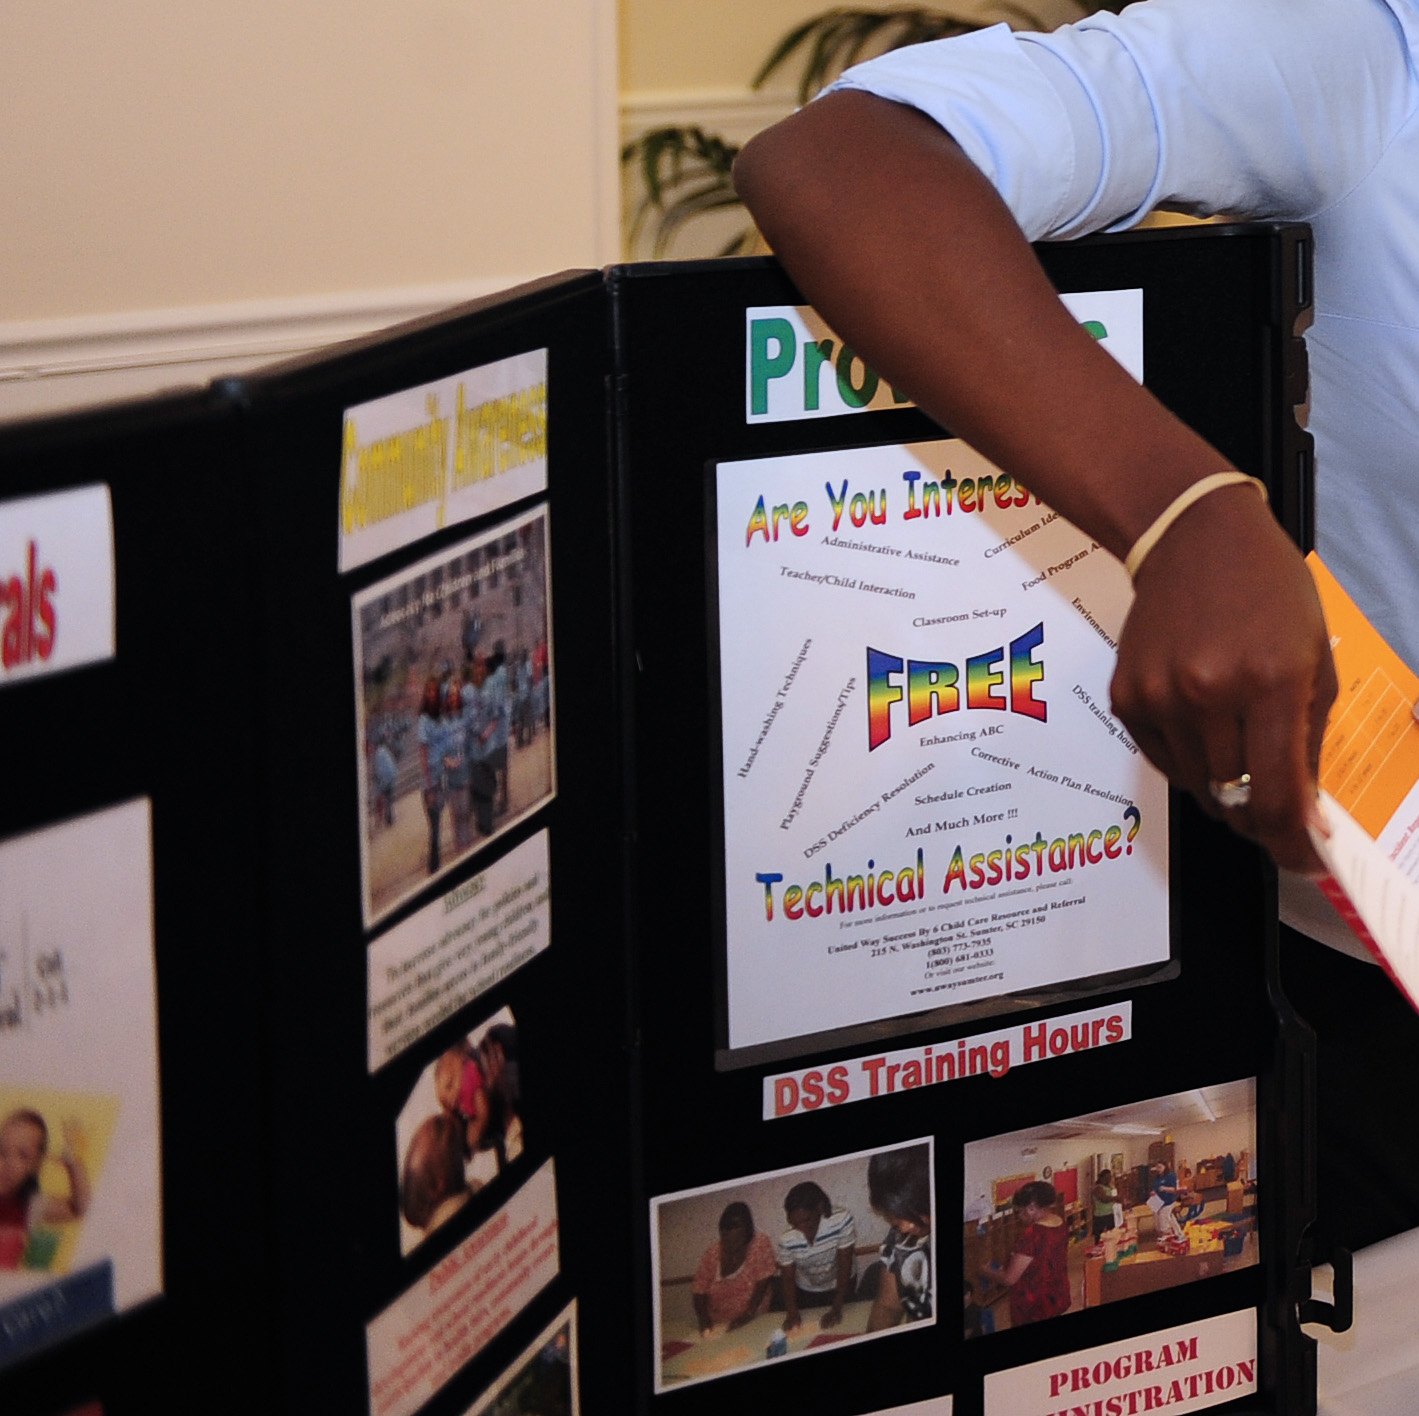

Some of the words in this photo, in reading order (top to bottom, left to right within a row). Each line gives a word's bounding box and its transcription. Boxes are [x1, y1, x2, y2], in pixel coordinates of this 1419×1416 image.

[746, 494, 810, 548] Are
[825, 479, 887, 531] You
[902, 469, 1042, 521] Interes
[983, 520, 1041, 559] Curriculum
[1040, 509, 1060, 528] Ide
[820, 535, 902, 557] Administrative
[904, 548, 960, 567] Assistance
[1022, 571, 1047, 591] Food
[1047, 549, 1089, 577] Program
[779, 566, 856, 589] Teacher/Child
[859, 580, 916, 600] Interaction
[912, 612, 970, 628] Classroom
[972, 607, 1007, 620] Set-up
[737, 701, 784, 778] Hand-washing
[777, 638, 812, 699] Techniques
[866, 621, 1047, 753] FREE
[920, 730, 977, 747] Enhancing
[979, 725, 1004, 737] ABC
[1071, 684, 1091, 705] DSS
[1088, 701, 1120, 736] training
[1116, 729, 1140, 755] hours
[780, 768, 815, 830] Playground
[810, 676, 857, 768] Suggestions/Tips
[971, 746, 1020, 770] Corrective
[1027, 765, 1059, 783] Action
[1060, 776, 1082, 791] Plan
[1083, 784, 1134, 807] Resolution
[803, 838, 828, 859] DSS
[828, 801, 881, 842] Deficiency
[881, 762, 936, 802] Resolution
[914, 788, 964, 806] Schedule
[967, 782, 1012, 797] Creation
[905, 824, 932, 838] And
[935, 816, 969, 832] Much
[973, 811, 1004, 825] More
[755, 846, 925, 922] Technical
[943, 806, 1142, 895] Assistance?
[827, 941, 858, 955] United
[860, 937, 880, 948] Way
[882, 931, 917, 944] Success
[918, 927, 930, 937] By
[932, 925, 939, 934] 6
[940, 920, 965, 932] Child
[967, 916, 989, 928] Care
[991, 908, 1030, 922] Resource
[1031, 903, 1048, 914] and
[1050, 896, 1086, 910] Referral
[901, 934, 954, 951] Washington
[1005, 920, 1018, 930] SC
[1020, 915, 1046, 927] 29150
[773, 1065, 851, 1117] DSS
[861, 1034, 1011, 1099] Training
[1022, 1013, 1124, 1061] Hours
[1047, 1359, 1256, 1416] NISTRATION
[1049, 1337, 1199, 1398] PROGRAM
